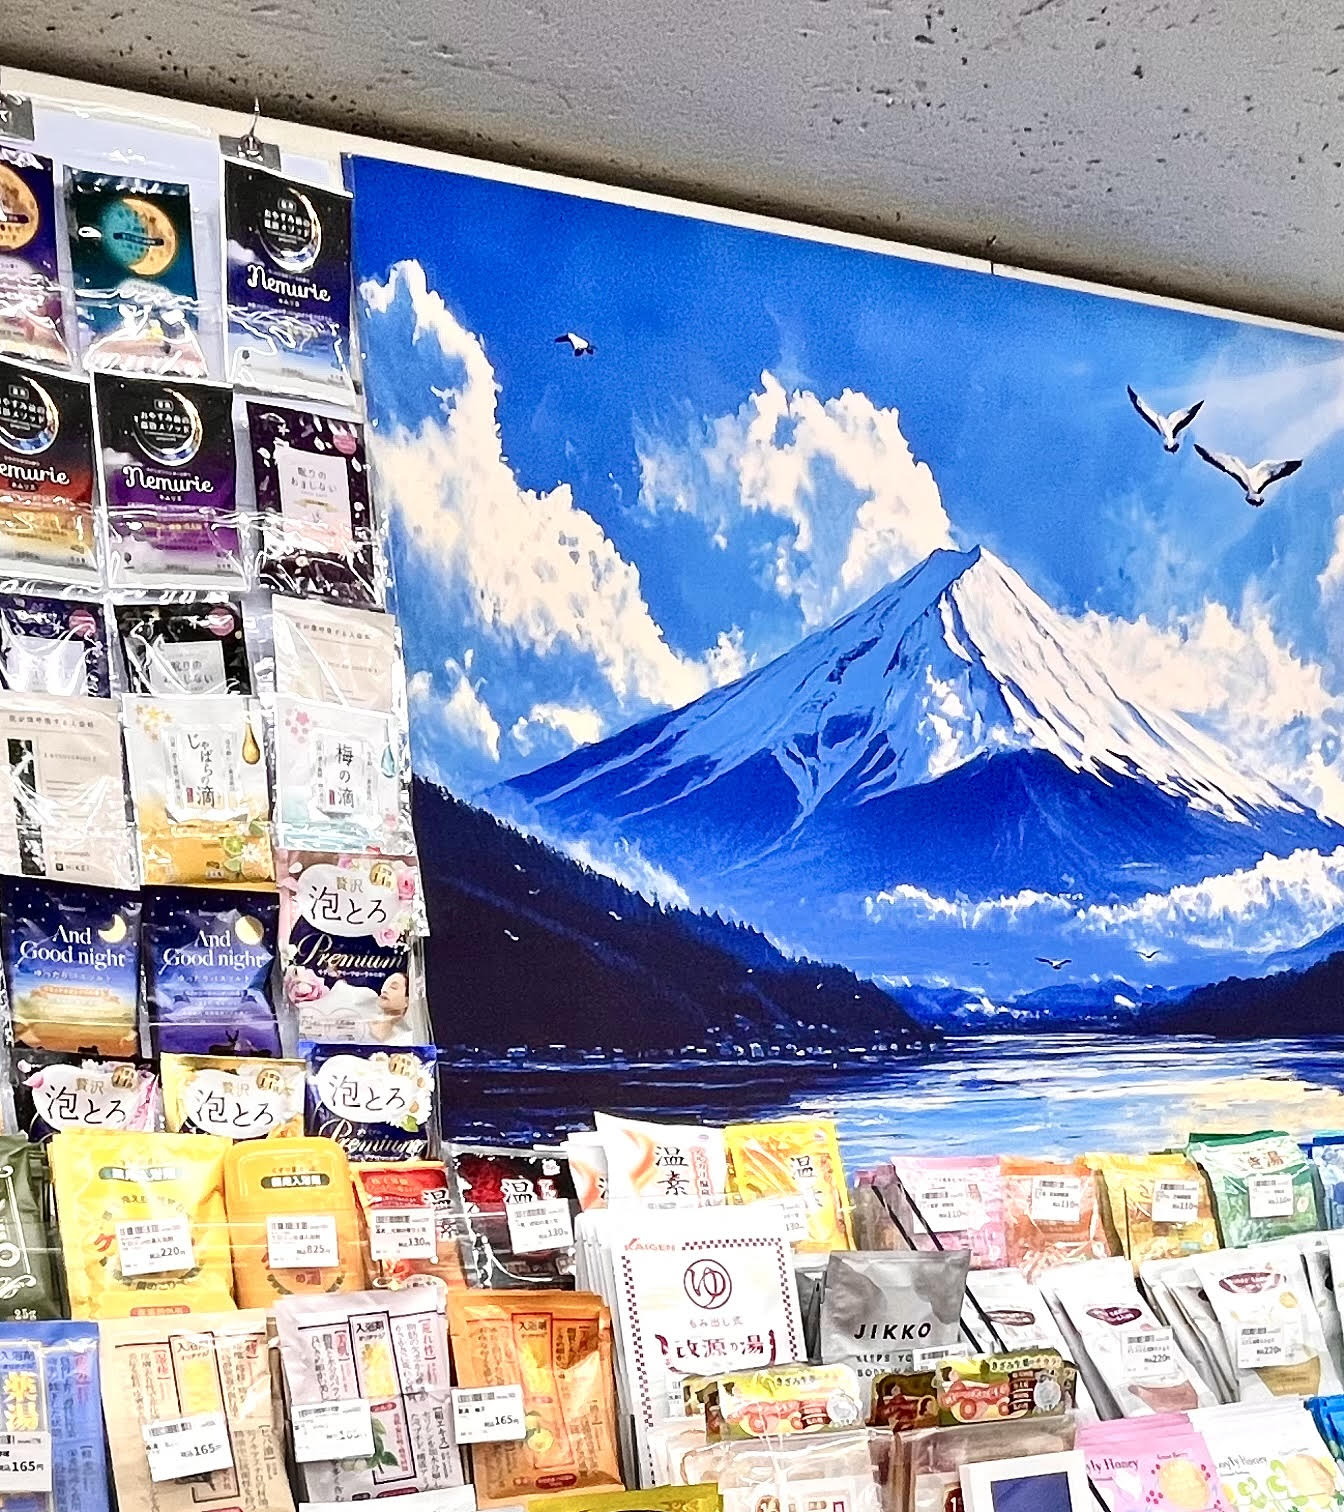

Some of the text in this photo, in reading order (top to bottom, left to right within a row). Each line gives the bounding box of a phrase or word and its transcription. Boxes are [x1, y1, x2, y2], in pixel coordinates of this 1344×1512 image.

[246, 264, 331, 303] Nemurie
[122, 465, 214, 494] Nemurie
[335, 742, 355, 809] 梅の滴
[309, 885, 387, 925] 泡とろ
[53, 925, 91, 945] And
[194, 929, 231, 949] And
[20, 941, 125, 968] Good night
[163, 947, 267, 969] Good night
[295, 933, 403, 968] Premium
[46, 1086, 127, 1126] 泡とろ
[329, 1074, 405, 1110] 泡とろ
[197, 1088, 274, 1127] 泡とろ
[656, 1146, 688, 1197] 温素
[357, 1320, 385, 1333] 入浴剤
[518, 1320, 548, 1332] 入浴剤
[854, 1322, 931, 1341] JIKKO
[1, 1349, 35, 1362] 入浴剤
